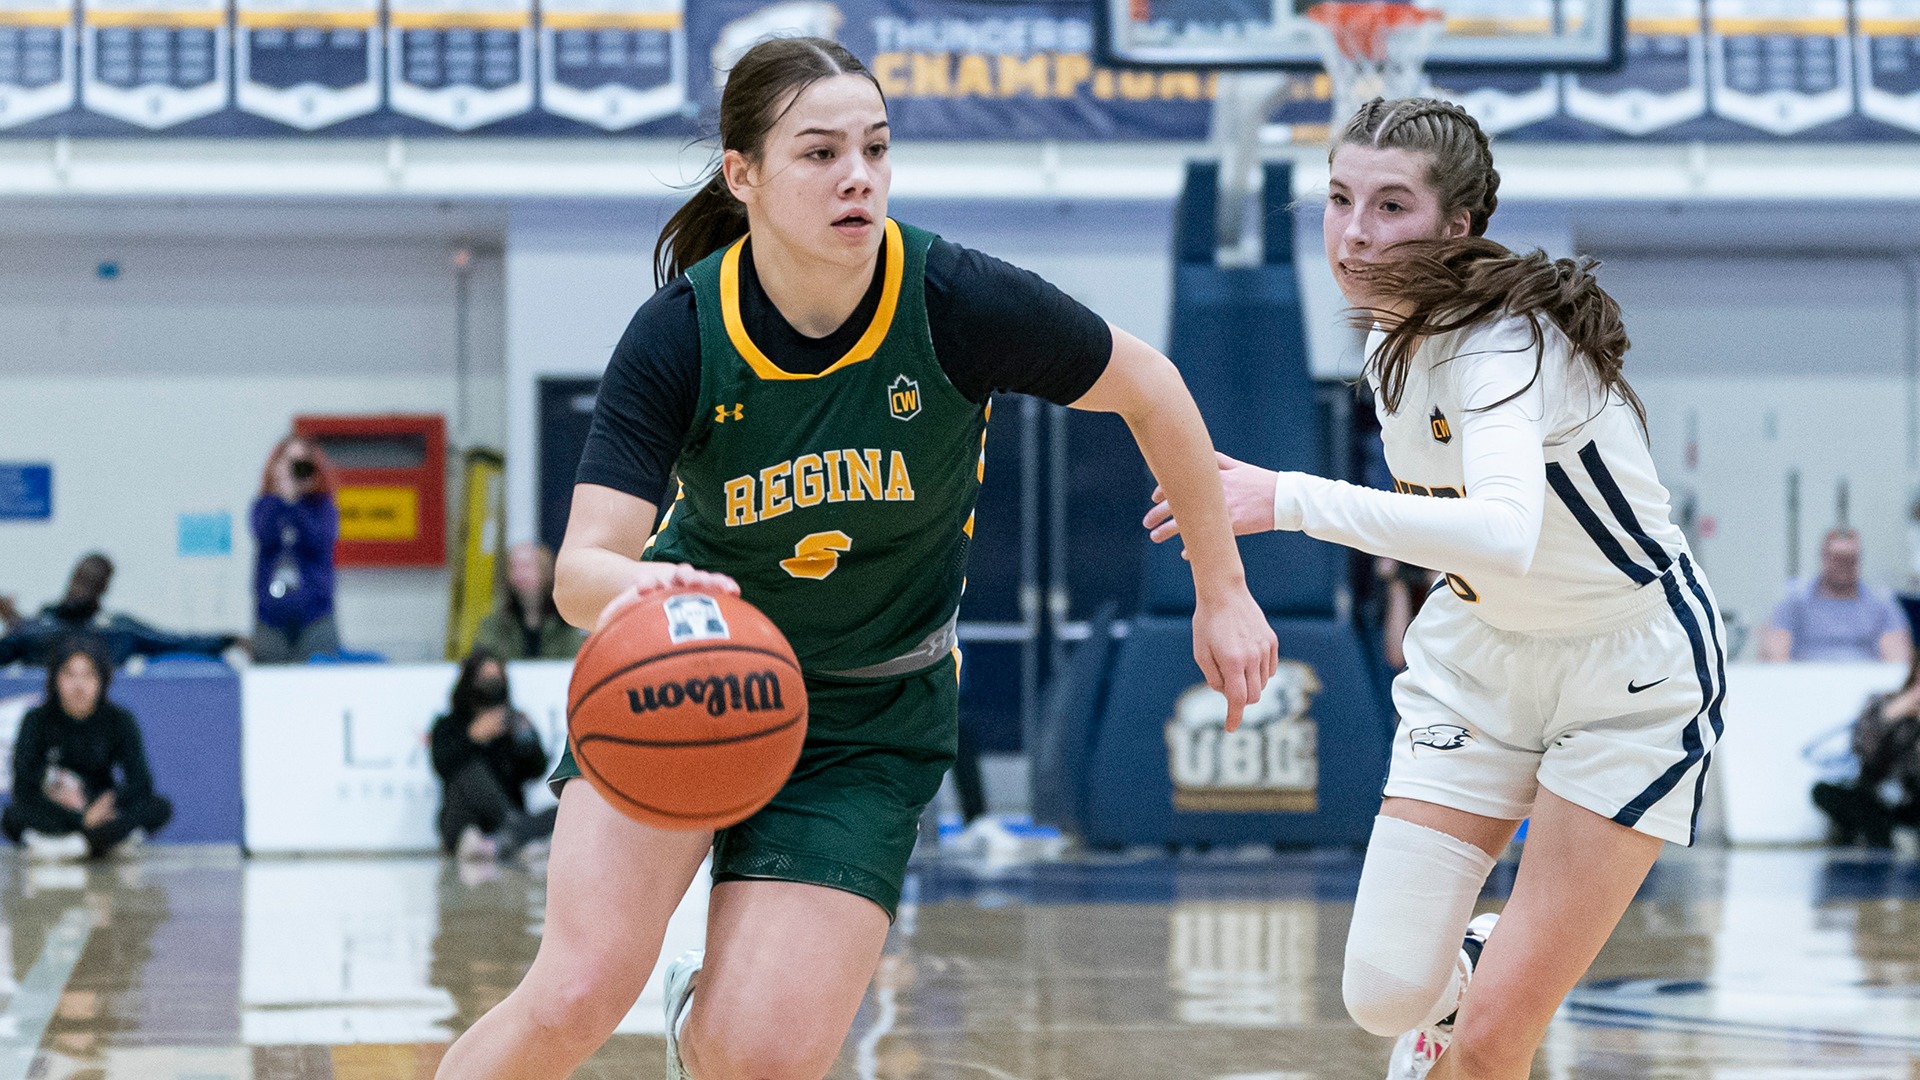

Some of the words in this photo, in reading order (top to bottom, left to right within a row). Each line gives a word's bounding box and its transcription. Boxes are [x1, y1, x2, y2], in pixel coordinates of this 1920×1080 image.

[892, 389, 917, 414] CW
[724, 448, 915, 527] REGINA
[626, 668, 785, 718] Wilson
[1164, 716, 1319, 792] UBC
